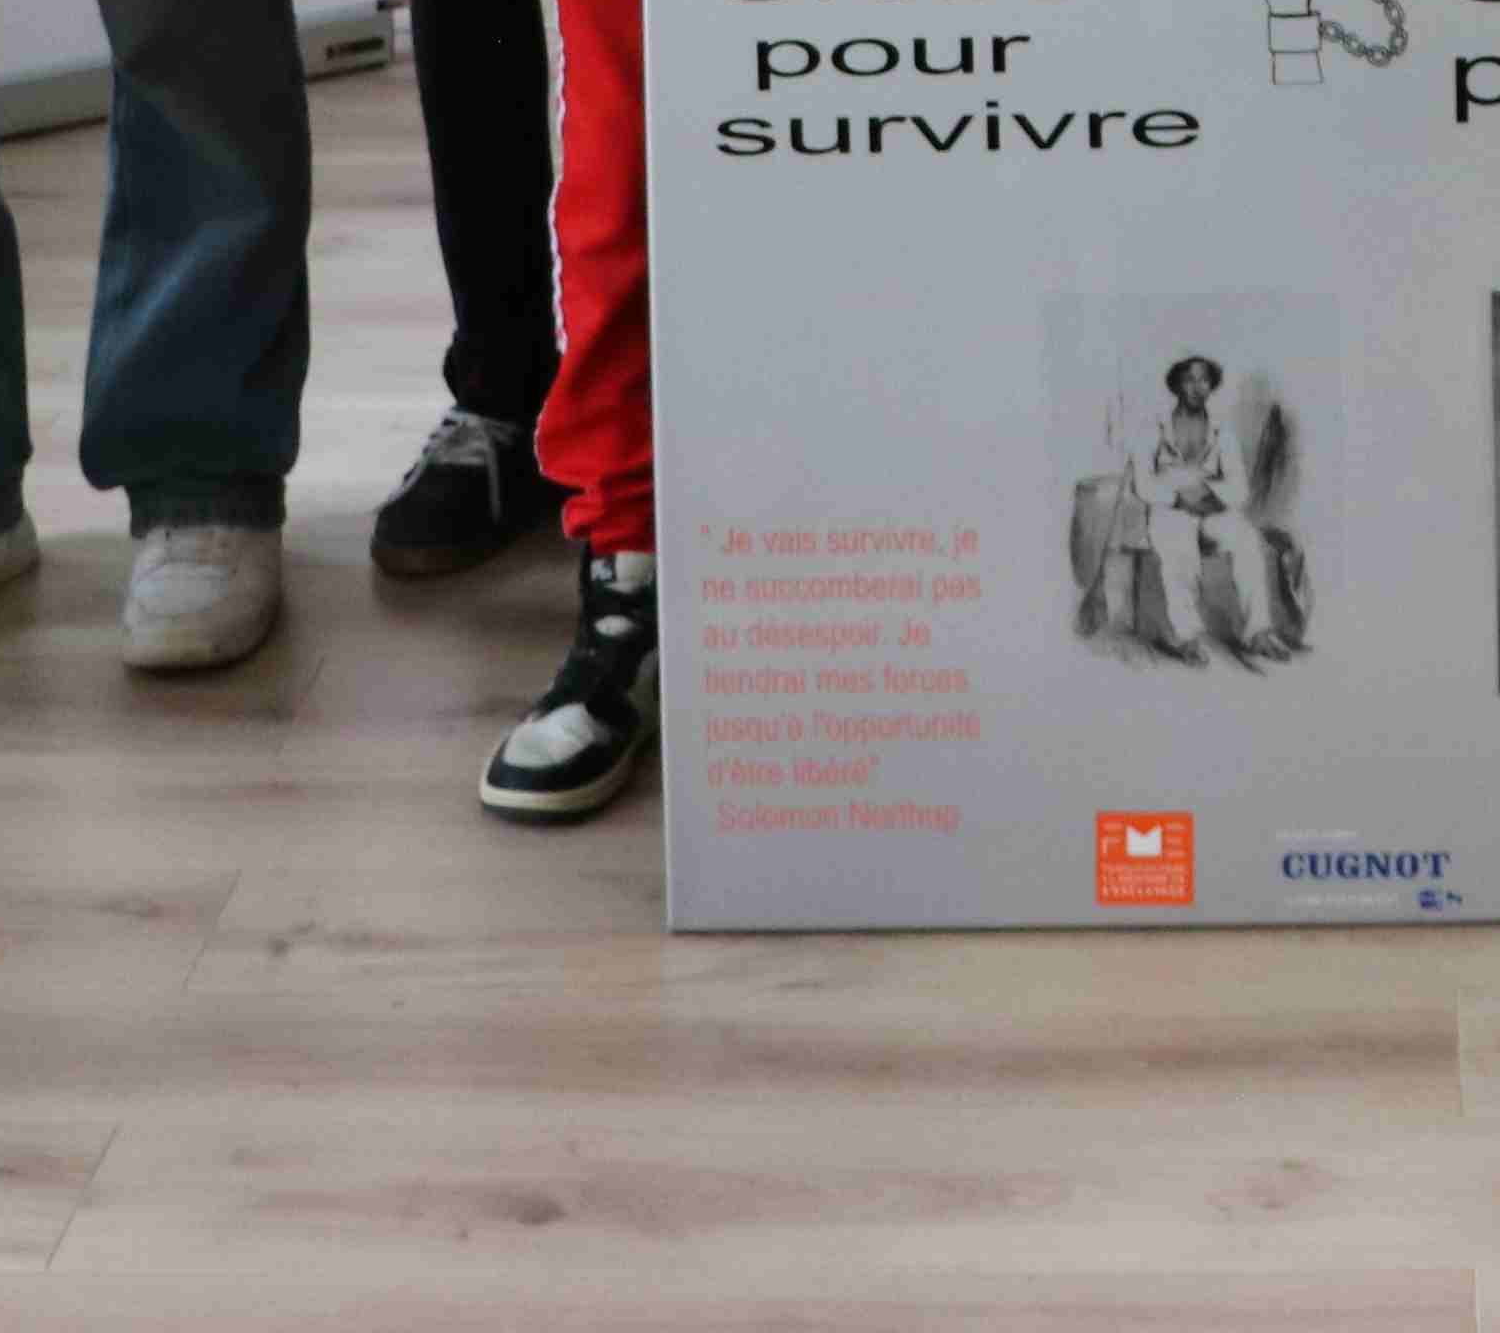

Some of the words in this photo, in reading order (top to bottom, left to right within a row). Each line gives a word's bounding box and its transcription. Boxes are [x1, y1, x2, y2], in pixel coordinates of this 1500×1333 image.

[755, 33, 1032, 92] pour
[716, 100, 1202, 158] survivre
[1281, 850, 1452, 880] CUGNOT
